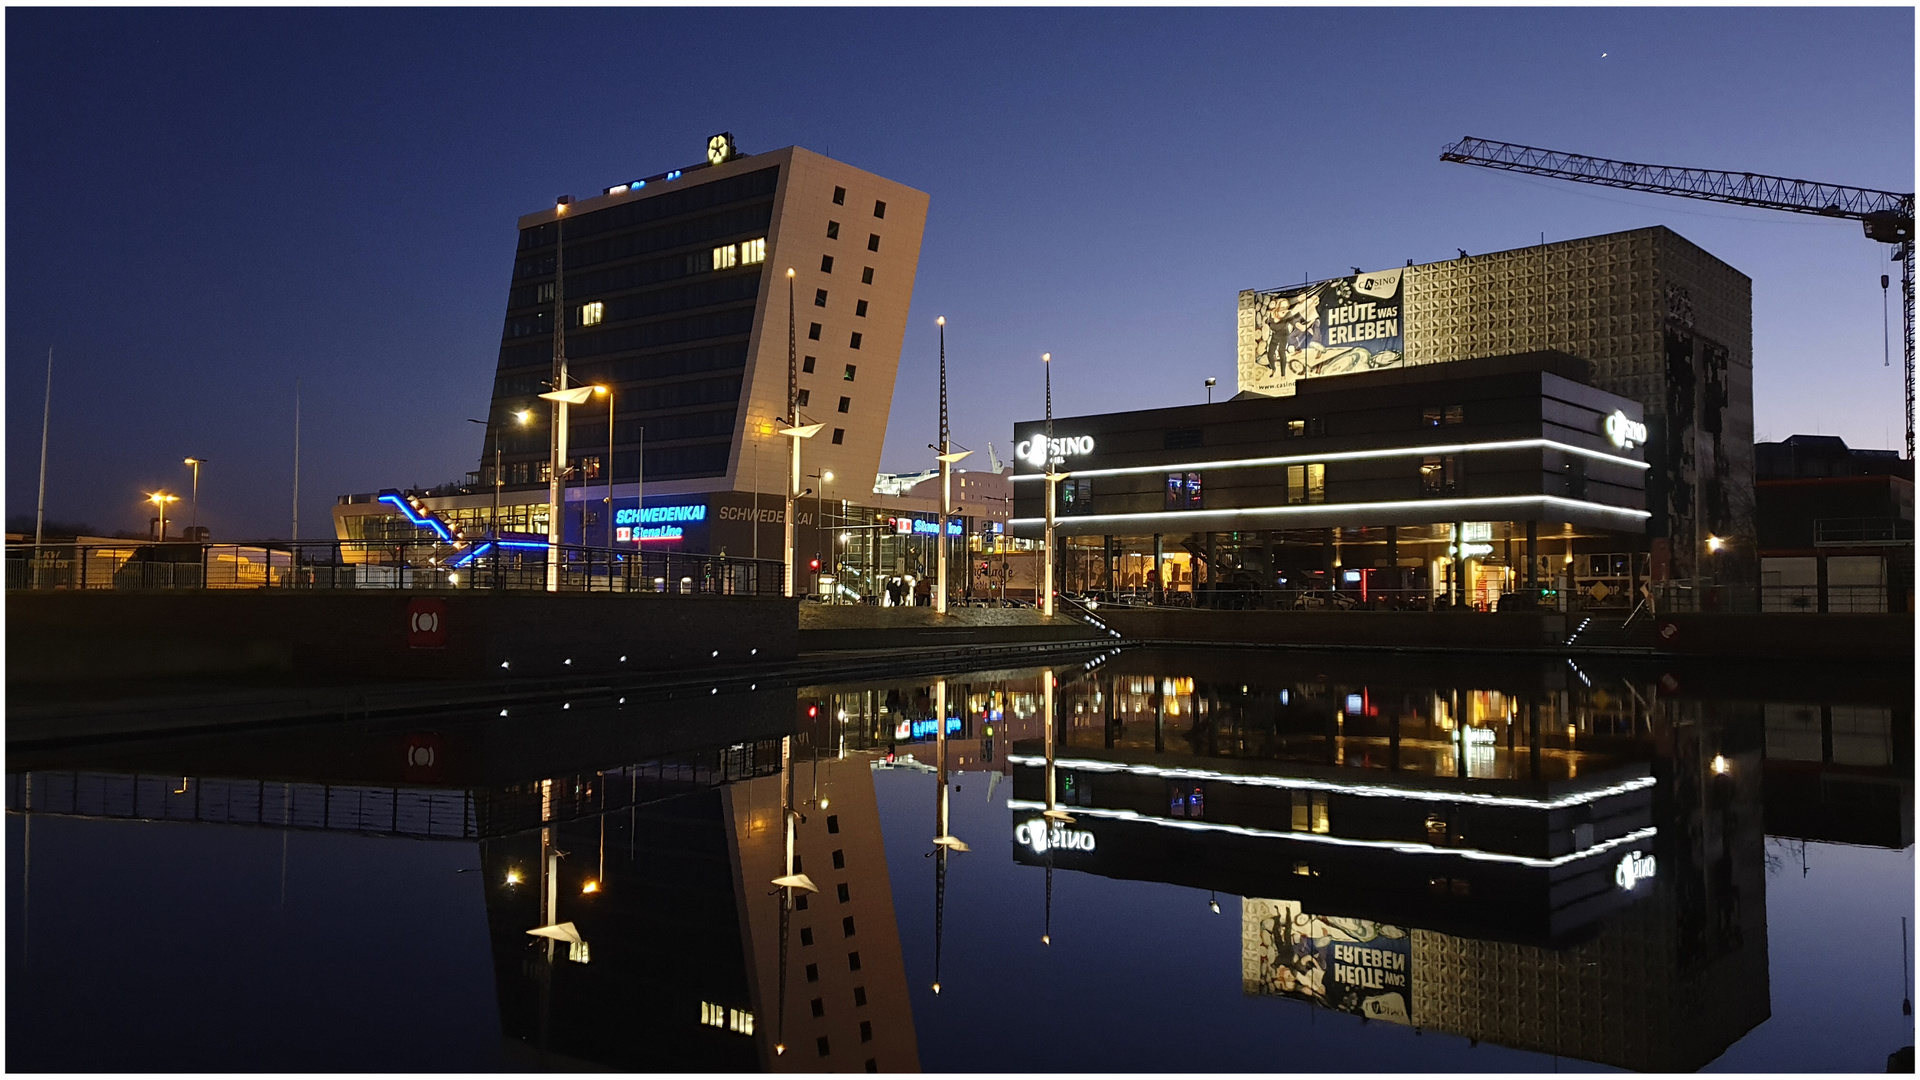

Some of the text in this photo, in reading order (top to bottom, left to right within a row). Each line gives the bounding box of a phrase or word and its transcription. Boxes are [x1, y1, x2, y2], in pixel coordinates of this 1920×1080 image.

[1358, 276, 1396, 291] CASINO
[1328, 301, 1398, 326] HEUTE WAS
[1328, 318, 1398, 346] ERLEBEN
[1606, 409, 1648, 448] CSINO
[1016, 433, 1095, 466] CSINO
[616, 504, 707, 524] SCHWEDENKAI
[719, 506, 813, 526] SCHWEDEKAI
